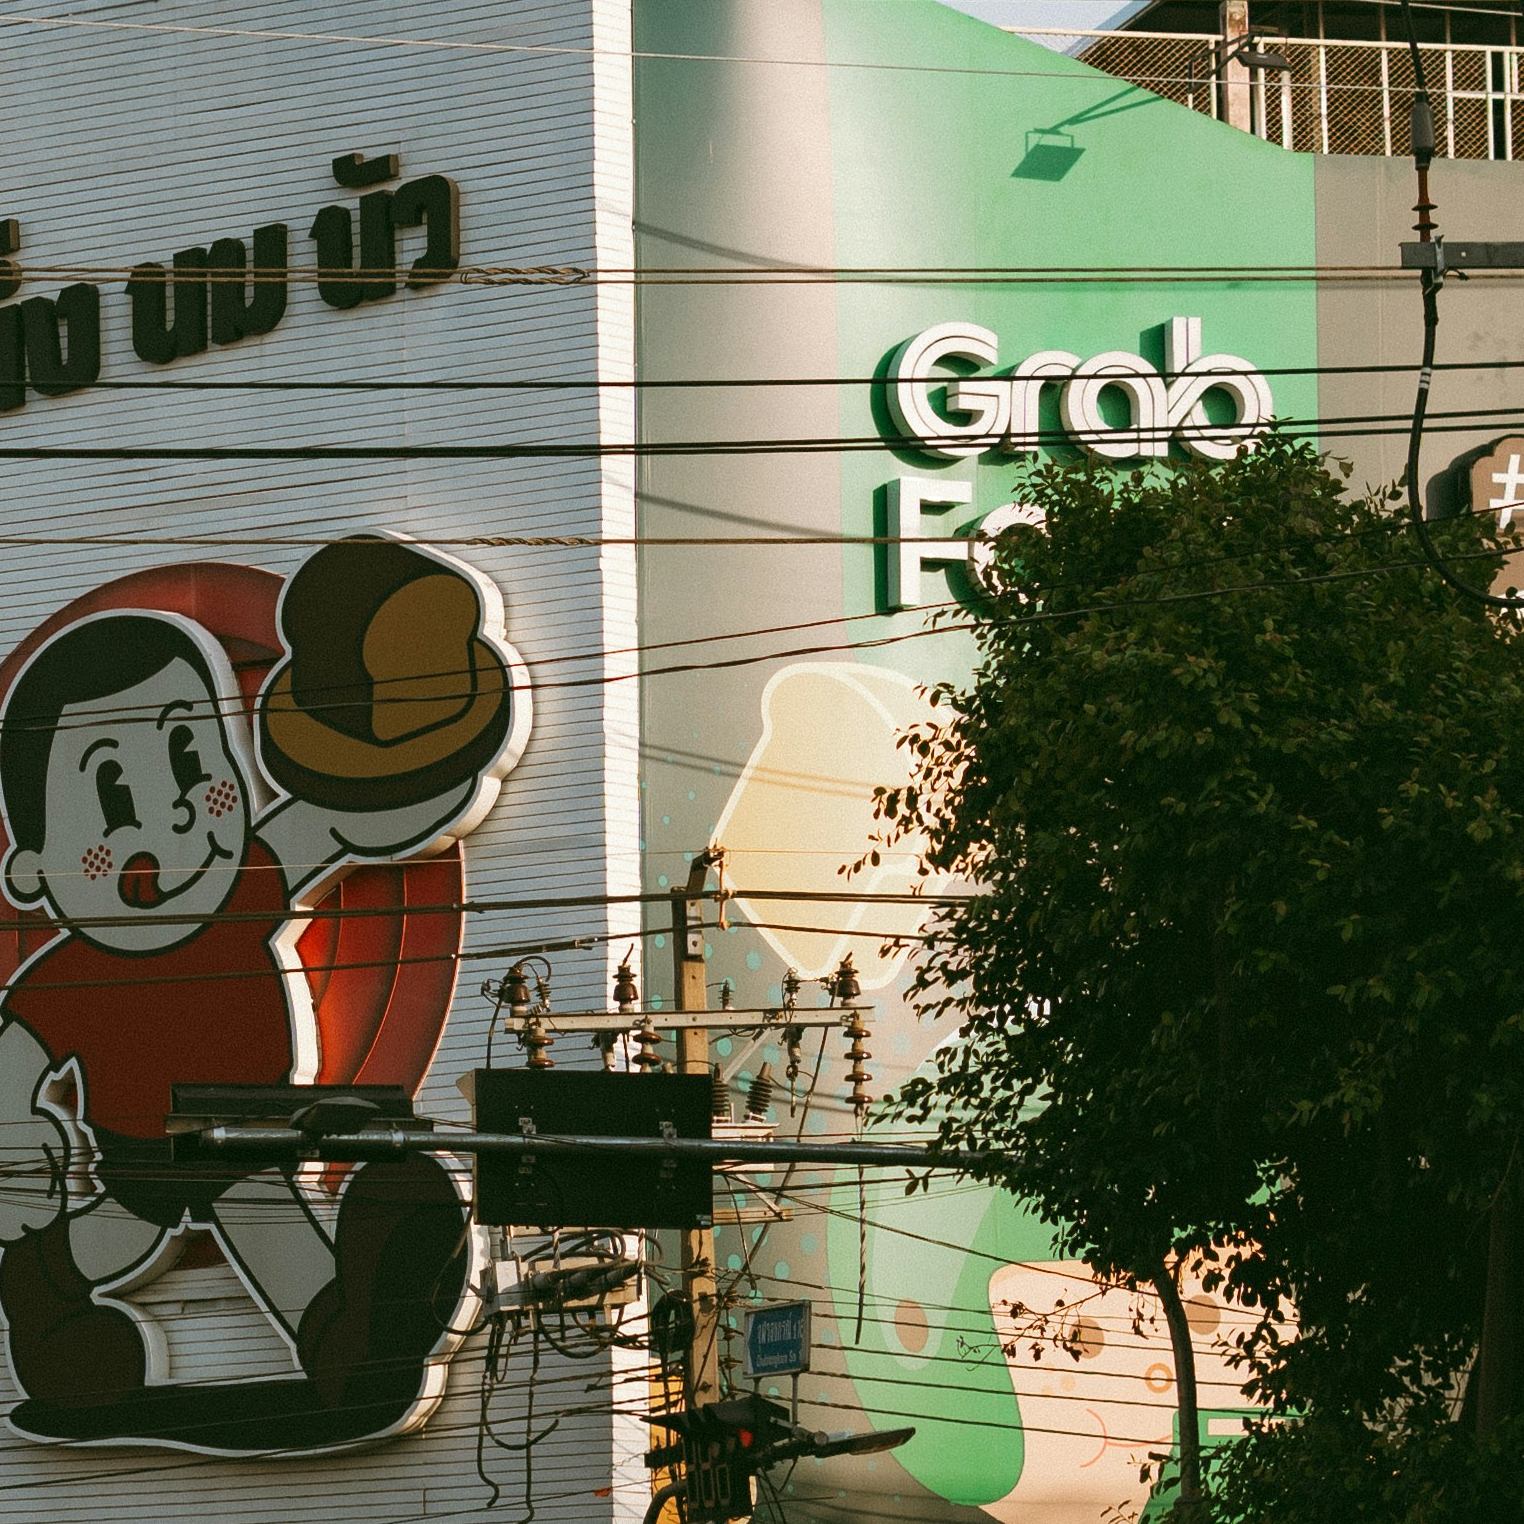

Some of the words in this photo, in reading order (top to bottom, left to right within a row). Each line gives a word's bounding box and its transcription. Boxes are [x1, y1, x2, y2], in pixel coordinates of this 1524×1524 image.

[124, 223, 288, 365] นม
[309, 152, 460, 310] นัว
[887, 316, 1273, 462] Grab
